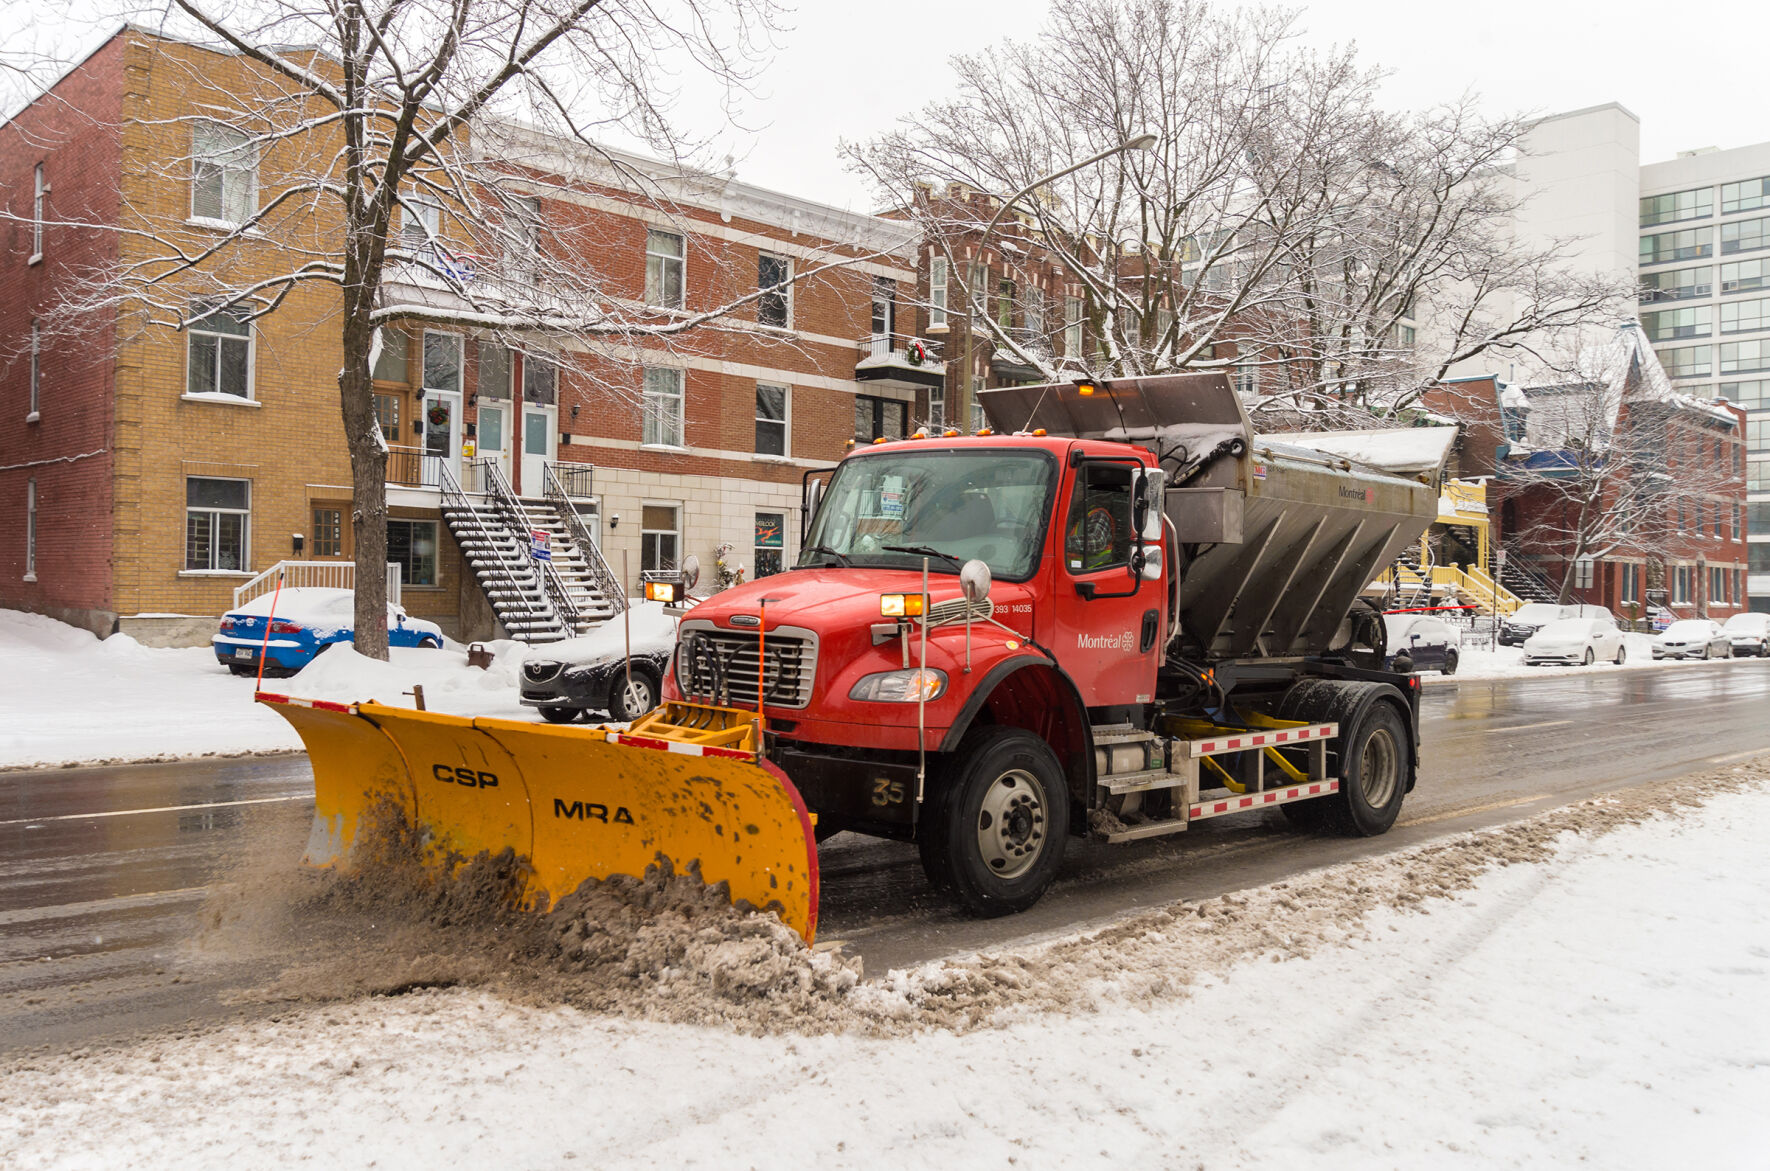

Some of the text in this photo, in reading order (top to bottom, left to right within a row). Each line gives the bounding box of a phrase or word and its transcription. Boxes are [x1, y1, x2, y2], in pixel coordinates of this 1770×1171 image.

[1338, 485, 1366, 501] Montréal
[994, 604, 1032, 614] 393 14035
[1077, 633, 1122, 649] Montréal
[432, 763, 499, 789] CSP
[872, 777, 905, 806] 35
[553, 798, 635, 826] MRA
